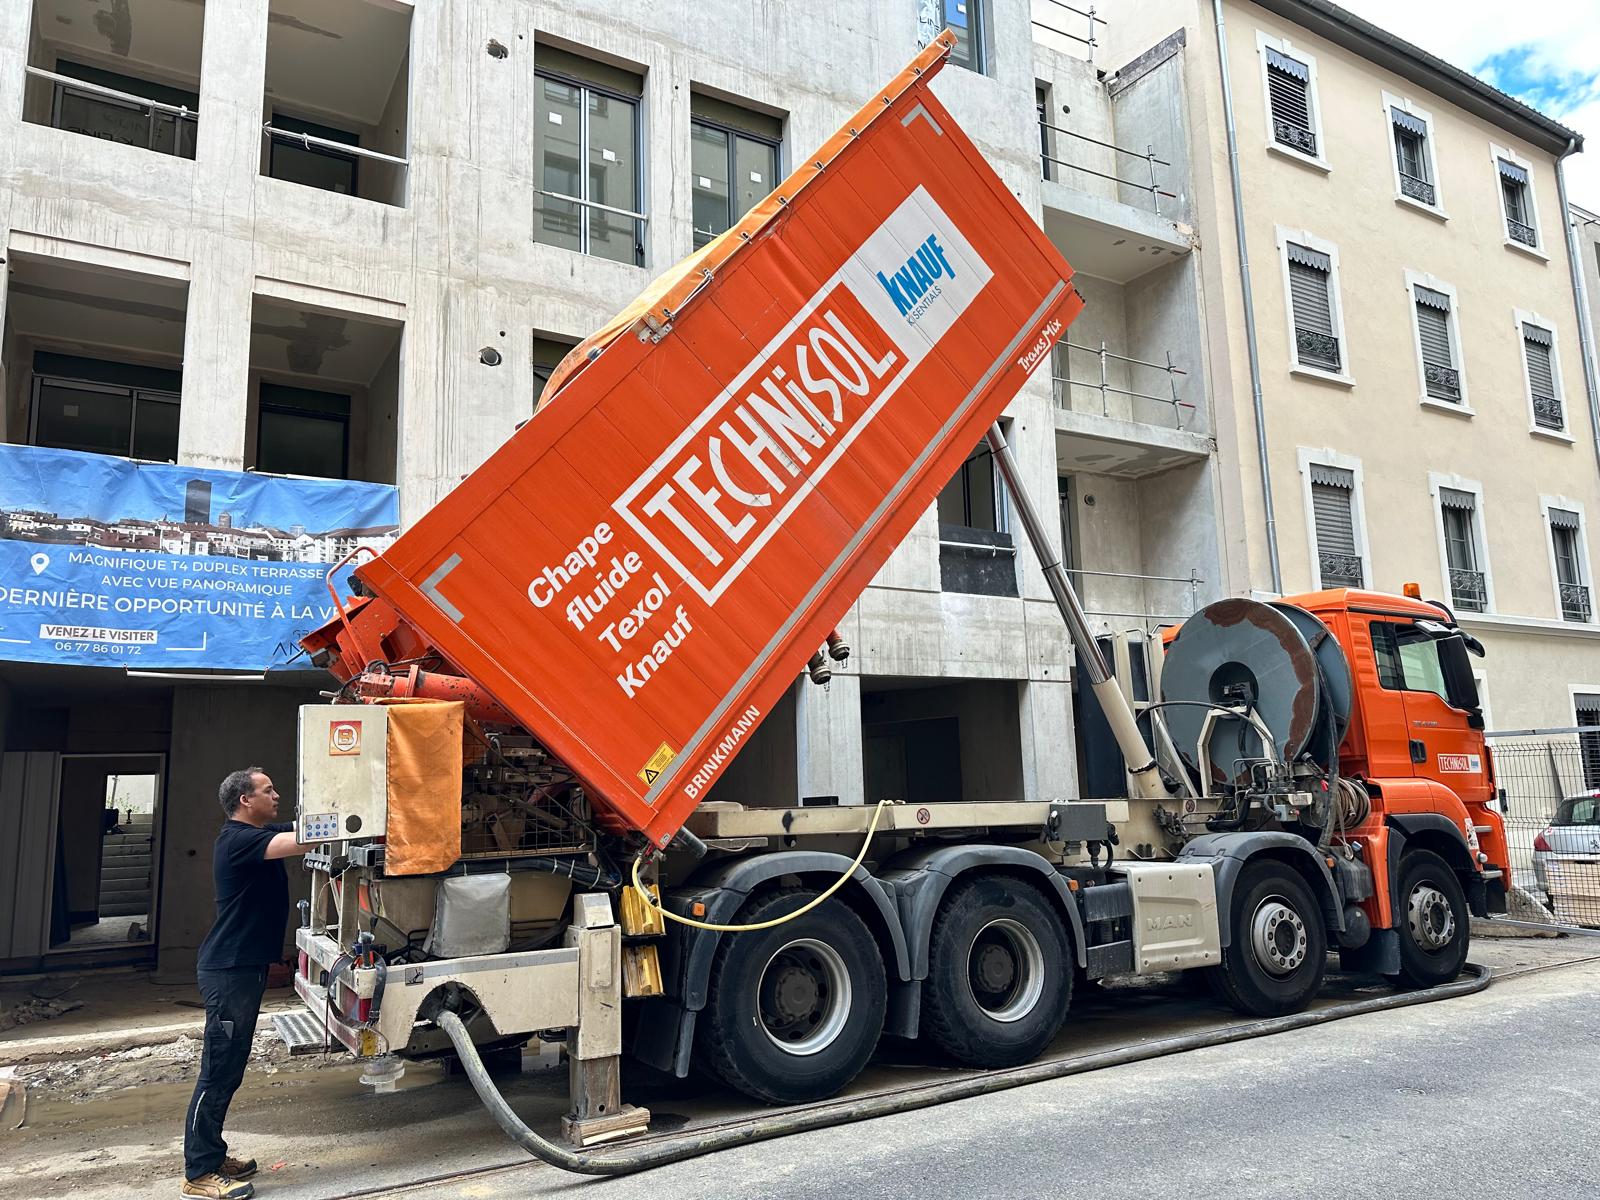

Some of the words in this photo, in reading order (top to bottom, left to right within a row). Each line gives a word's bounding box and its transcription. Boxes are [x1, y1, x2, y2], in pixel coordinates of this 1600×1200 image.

[876, 233, 956, 317] KNAUF
[68, 552, 166, 571] MAGNIFIQUE
[171, 560, 188, 571] T4
[192, 561, 248, 576] DUPLEX
[251, 566, 324, 579] TERRASSE
[101, 575, 144, 588] AVEC
[147, 577, 178, 588] VUE
[182, 579, 292, 597] PANORAMIQUE
[527, 521, 615, 608] Chape
[565, 550, 643, 632] fluide
[46, 625, 91, 638] VENEZ
[92, 628, 106, 639] LE
[109, 630, 155, 641] VISITER
[114, 597, 265, 619] OPPORTUNITÉ
[270, 601, 285, 619] À
[291, 605, 314, 619] LA
[598, 572, 672, 653] Texol
[55, 641, 72, 652] 06
[75, 643, 89, 652] 77
[92, 643, 109, 653] 86
[111, 645, 123, 654] 01
[127, 645, 141, 655] 72
[616, 605, 694, 700] Knauf
[683, 704, 761, 799] BRINKMANN
[1147, 913, 1193, 932] MAN
